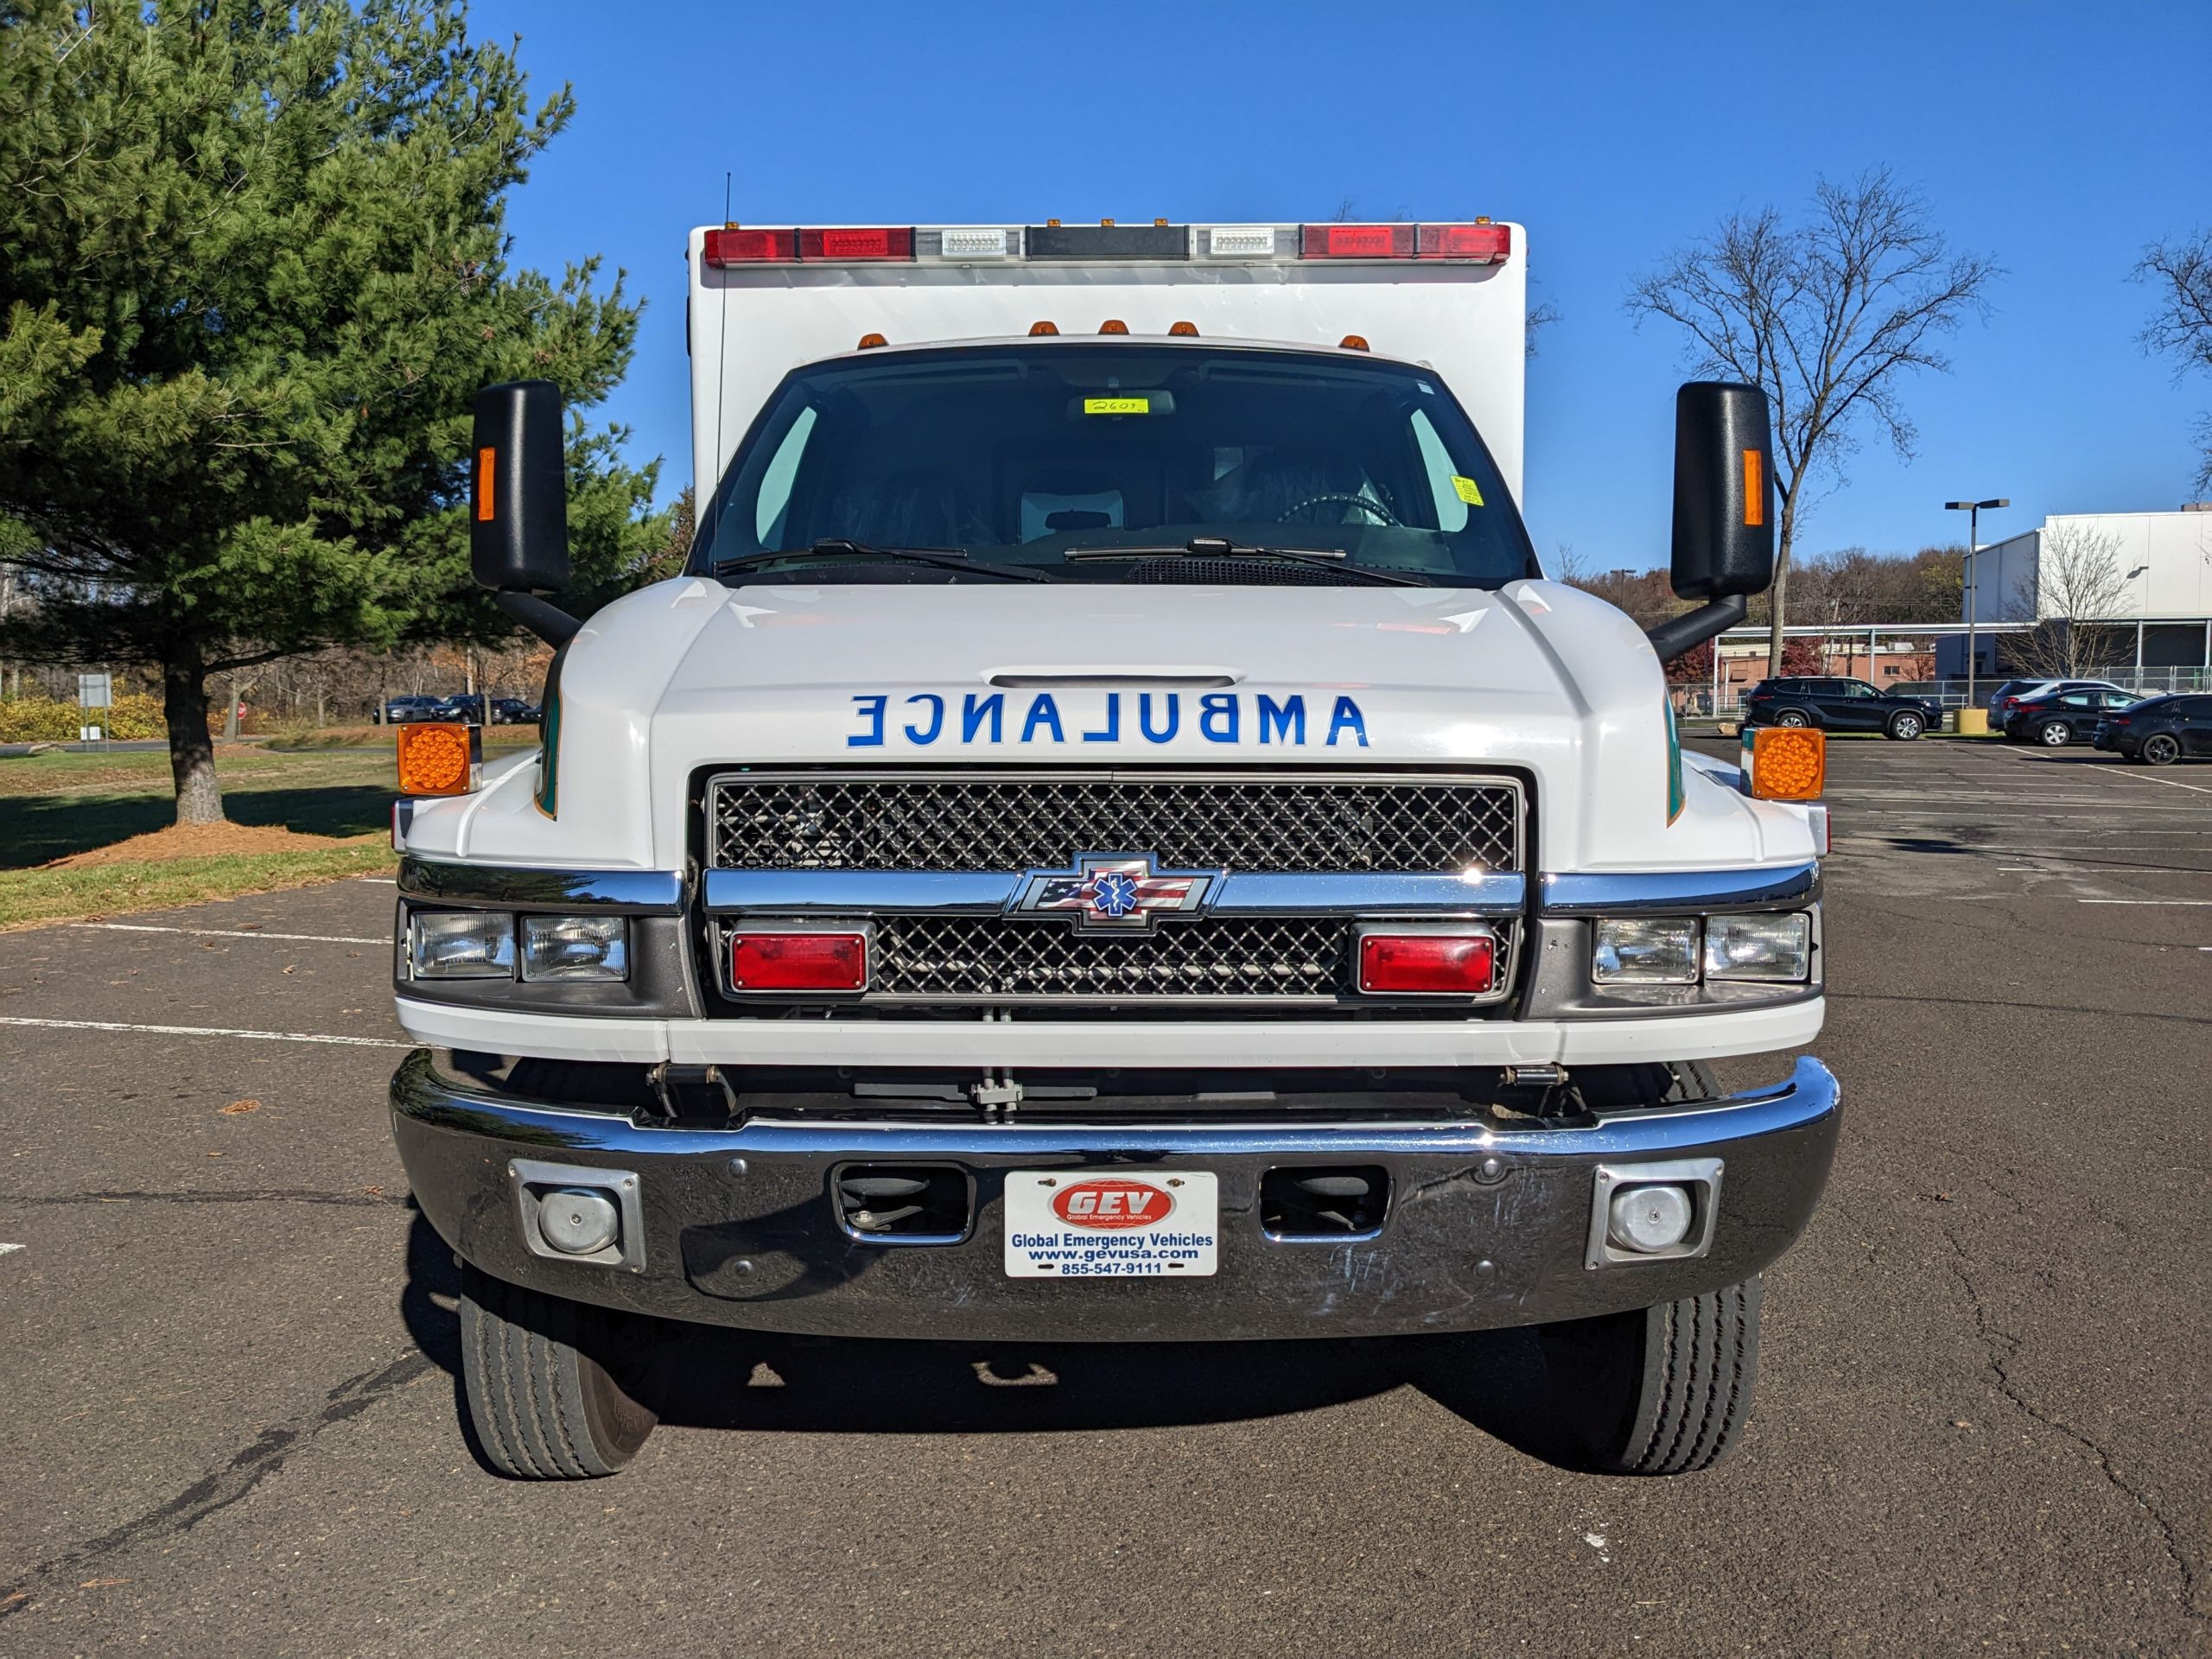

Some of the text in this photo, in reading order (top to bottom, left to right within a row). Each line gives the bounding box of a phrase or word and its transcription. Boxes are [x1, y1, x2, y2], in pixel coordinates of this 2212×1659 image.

[1067, 1192, 1154, 1214] GEV
[1012, 1233, 1213, 1249] Global Emergency Vehicles
[1028, 1249, 1198, 1262] www.gevusa.com
[1061, 1263, 1161, 1274] 855-547-9111
